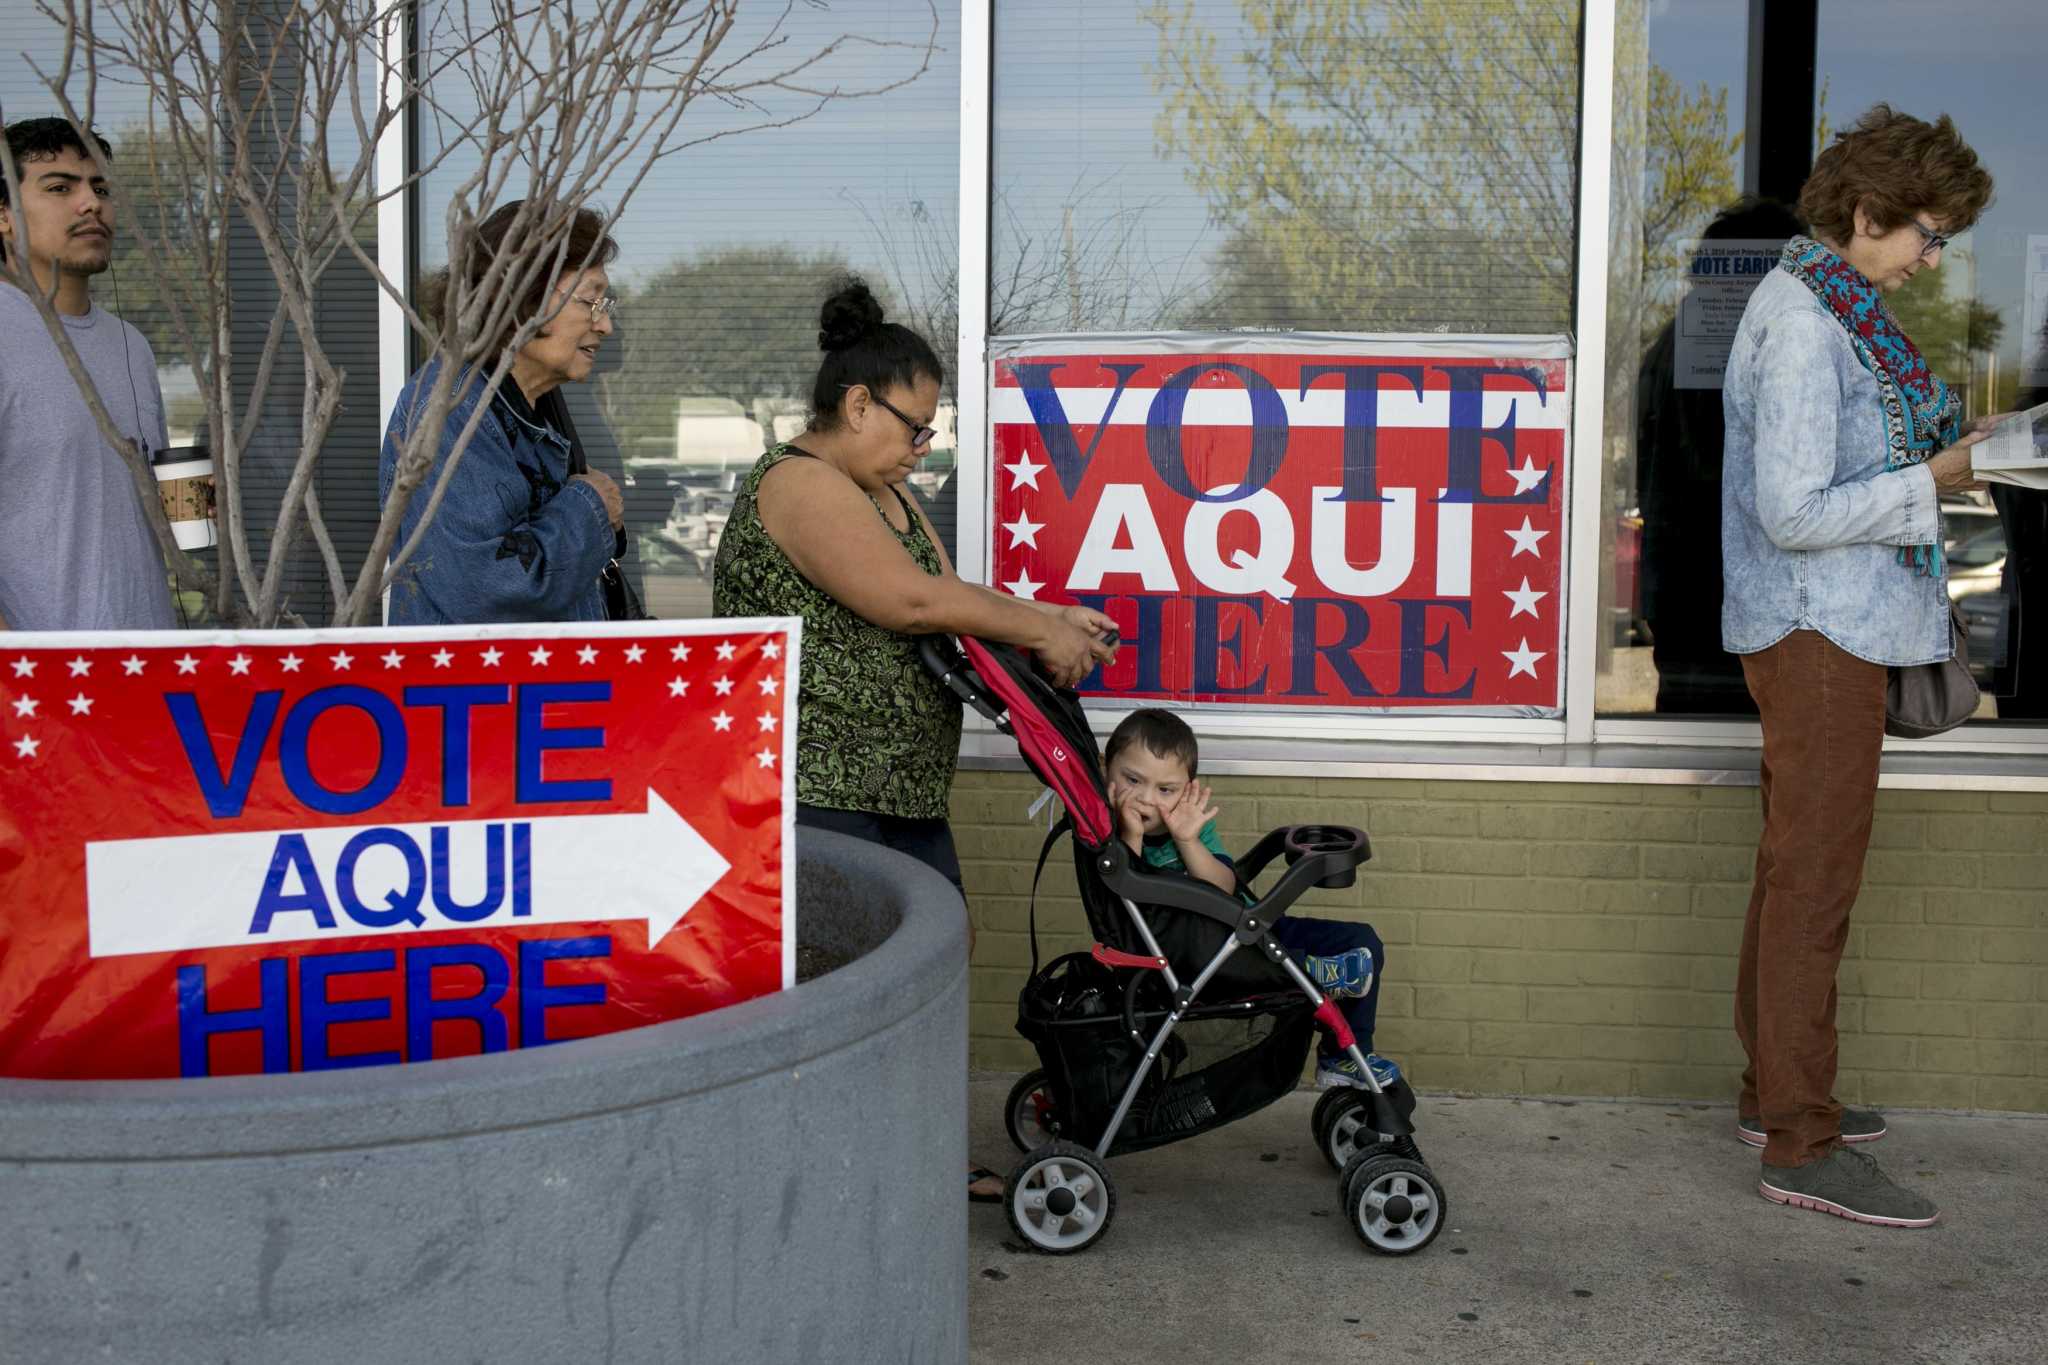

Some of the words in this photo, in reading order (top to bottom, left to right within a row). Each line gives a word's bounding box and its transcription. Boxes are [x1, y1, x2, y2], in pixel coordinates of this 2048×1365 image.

[1691, 256, 1730, 274] VOTE
[1734, 256, 1780, 274] EARLY
[1010, 362, 1555, 503] VOTE
[1065, 483, 1473, 604] AQUI
[1064, 593, 1477, 699] HERE
[164, 680, 612, 819] VOTE
[248, 822, 532, 935] AQUI
[177, 936, 611, 1078] HERE
